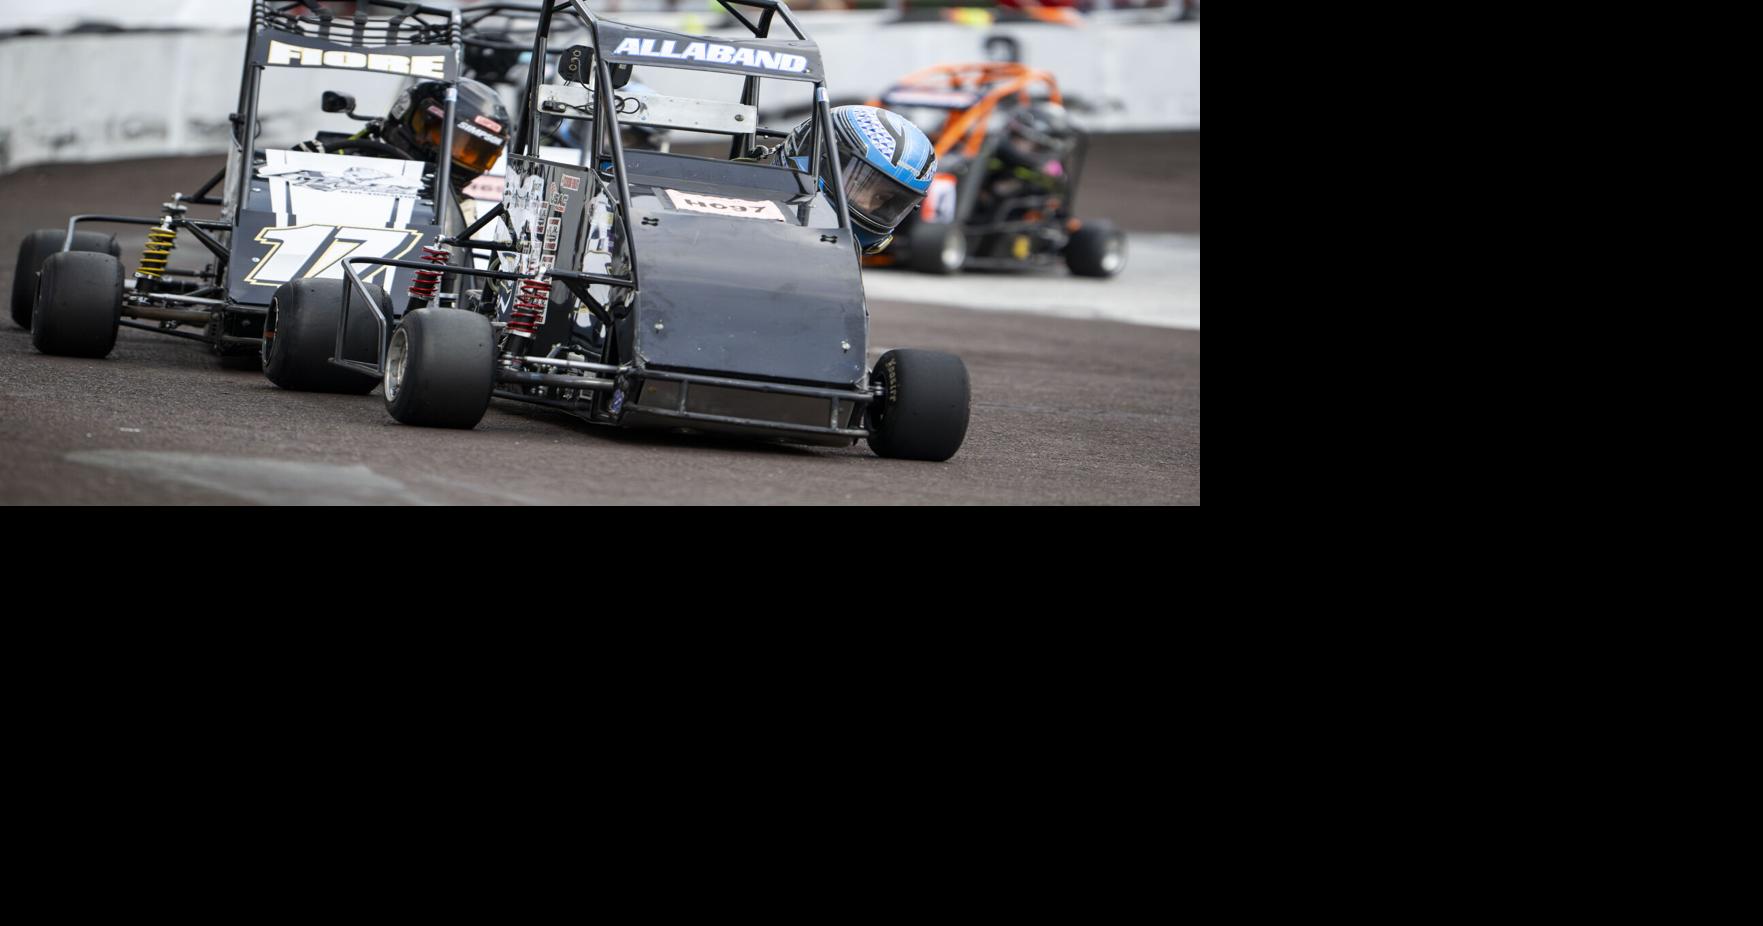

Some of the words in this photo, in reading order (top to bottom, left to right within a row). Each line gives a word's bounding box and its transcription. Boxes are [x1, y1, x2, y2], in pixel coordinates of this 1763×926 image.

[268, 39, 445, 79] FIORE
[613, 37, 807, 73] ALLABAND
[244, 224, 424, 287] 17
